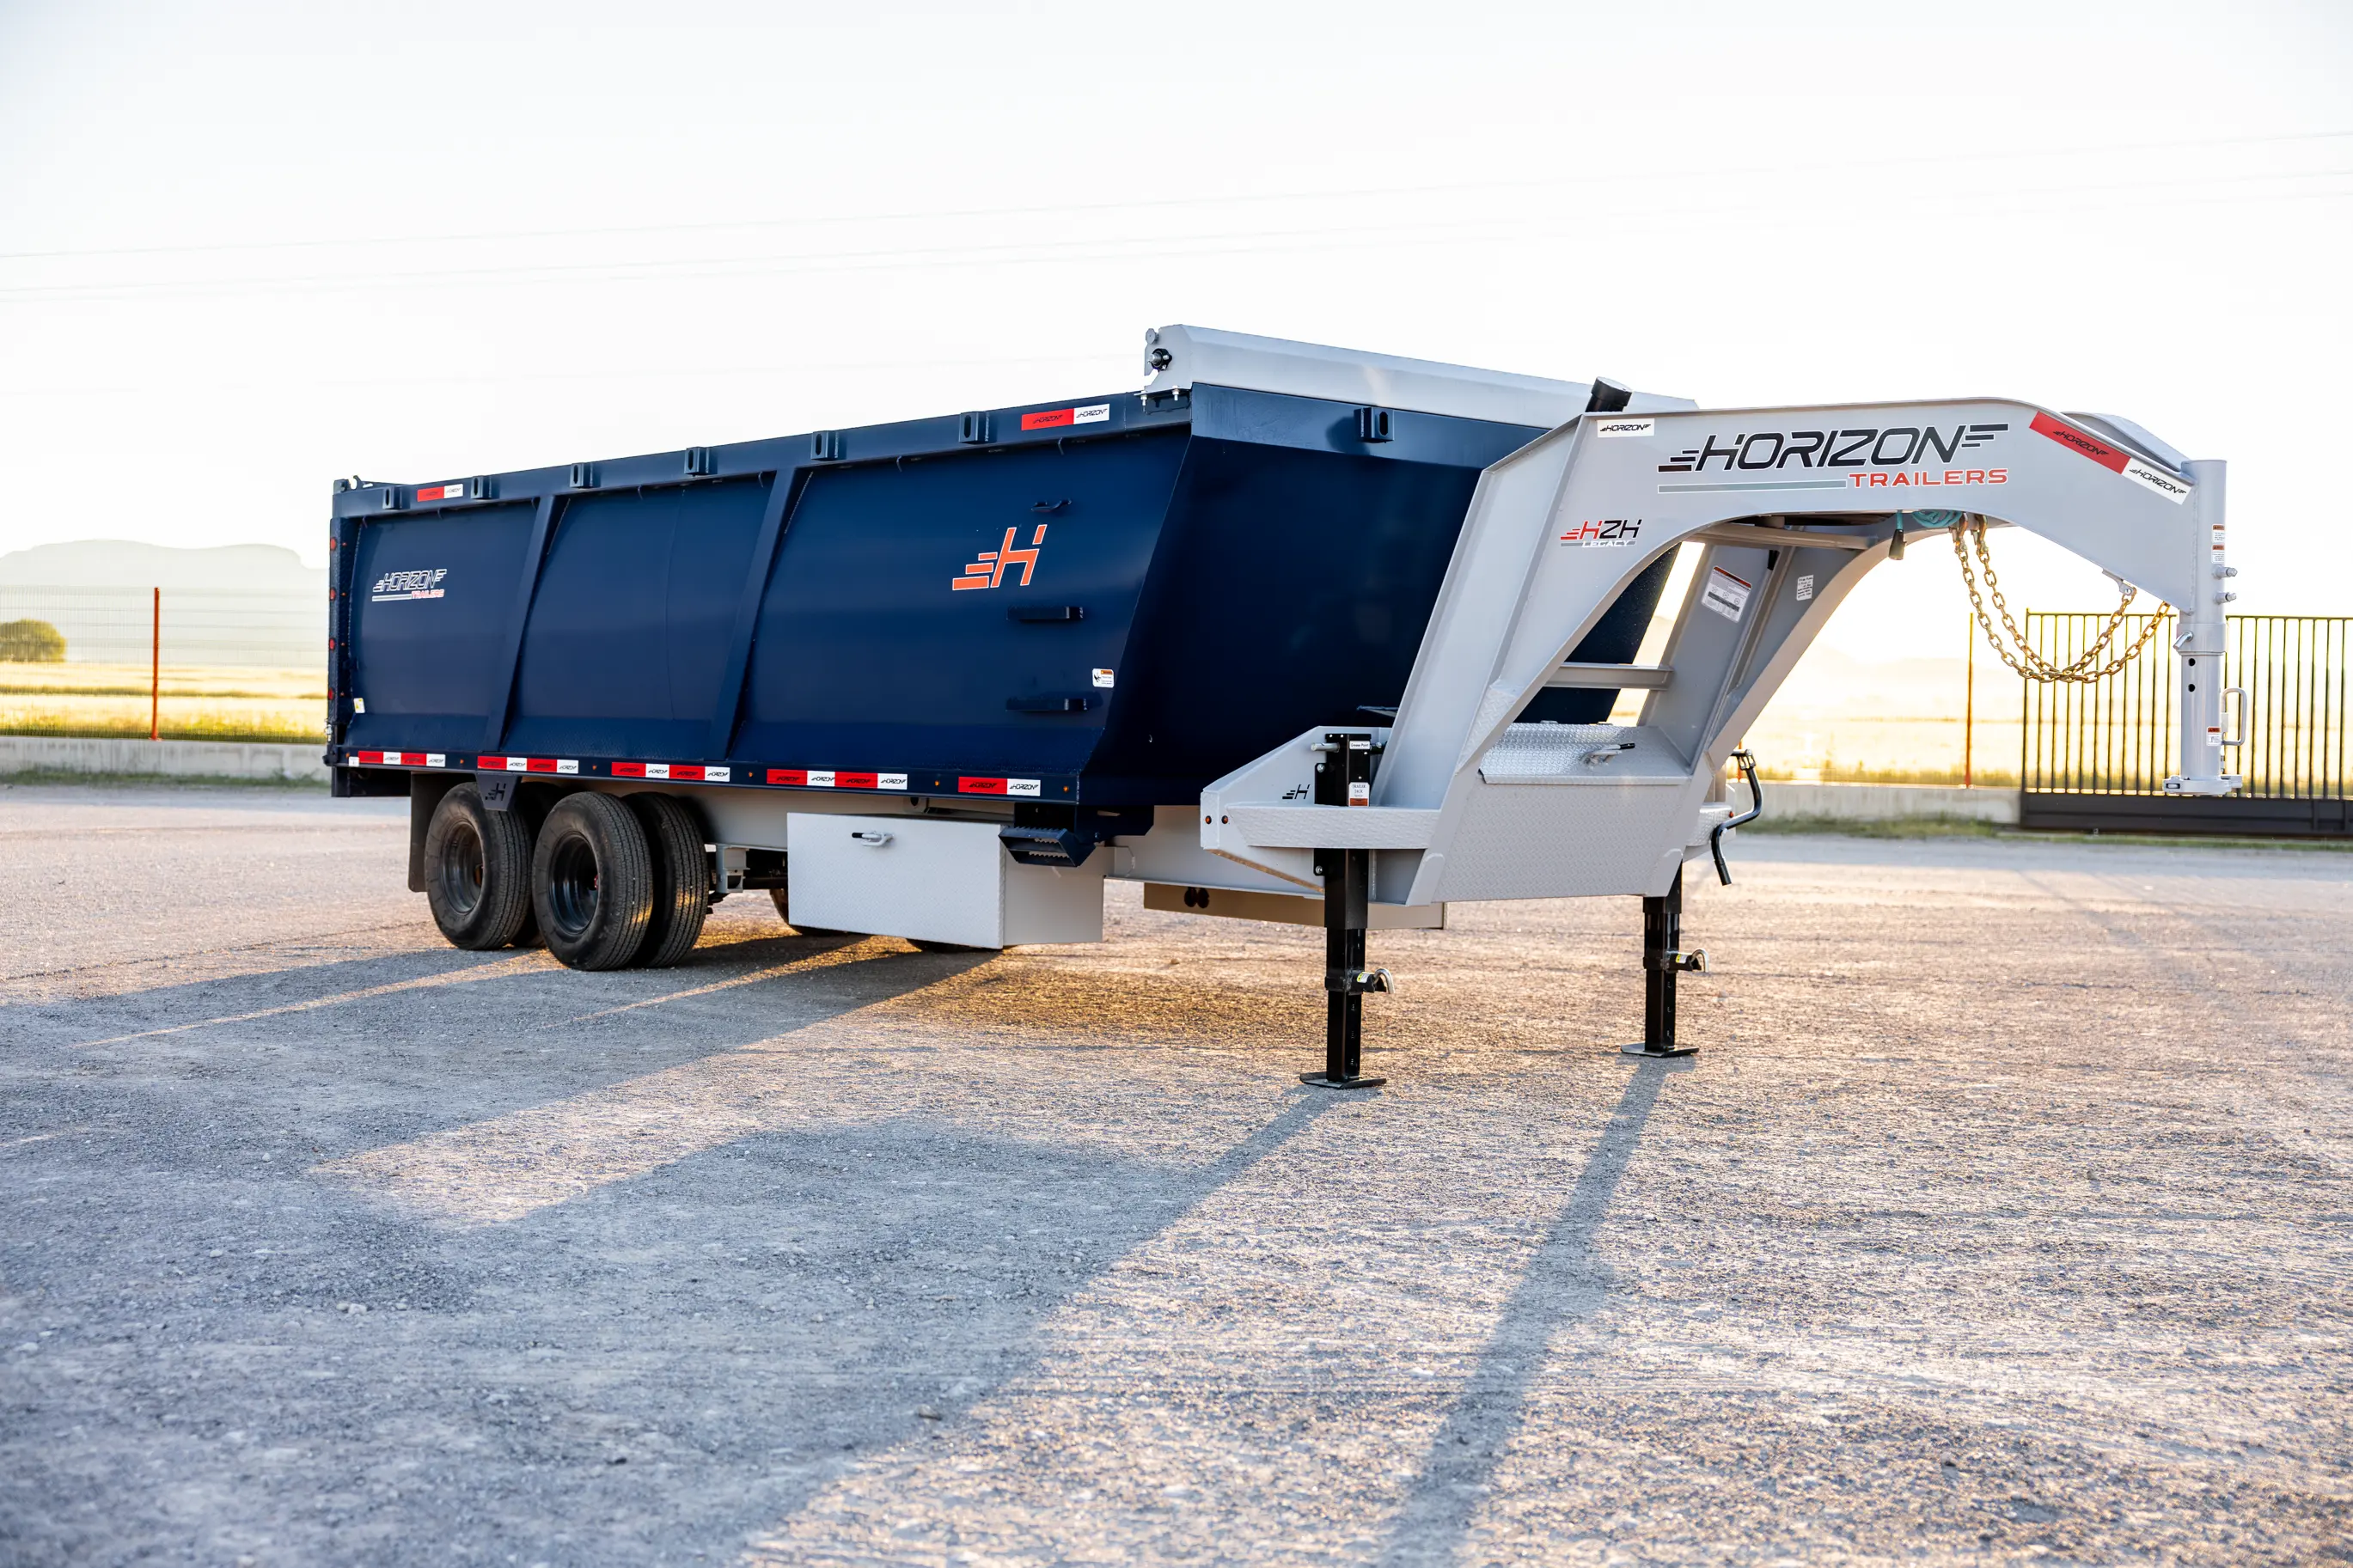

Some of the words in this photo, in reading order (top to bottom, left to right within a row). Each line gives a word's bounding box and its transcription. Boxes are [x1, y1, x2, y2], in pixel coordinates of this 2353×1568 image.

[1600, 423, 1650, 433] HORIZON
[1695, 424, 1968, 472] HORIZON
[2056, 431, 2107, 456] HORIZON
[1849, 468, 2009, 490] TRAILERS
[2131, 467, 2185, 495] HORIZON
[1581, 540, 1630, 548] LEGACY
[376, 569, 443, 592] HORIZON
[411, 589, 445, 599] TRAILERS
